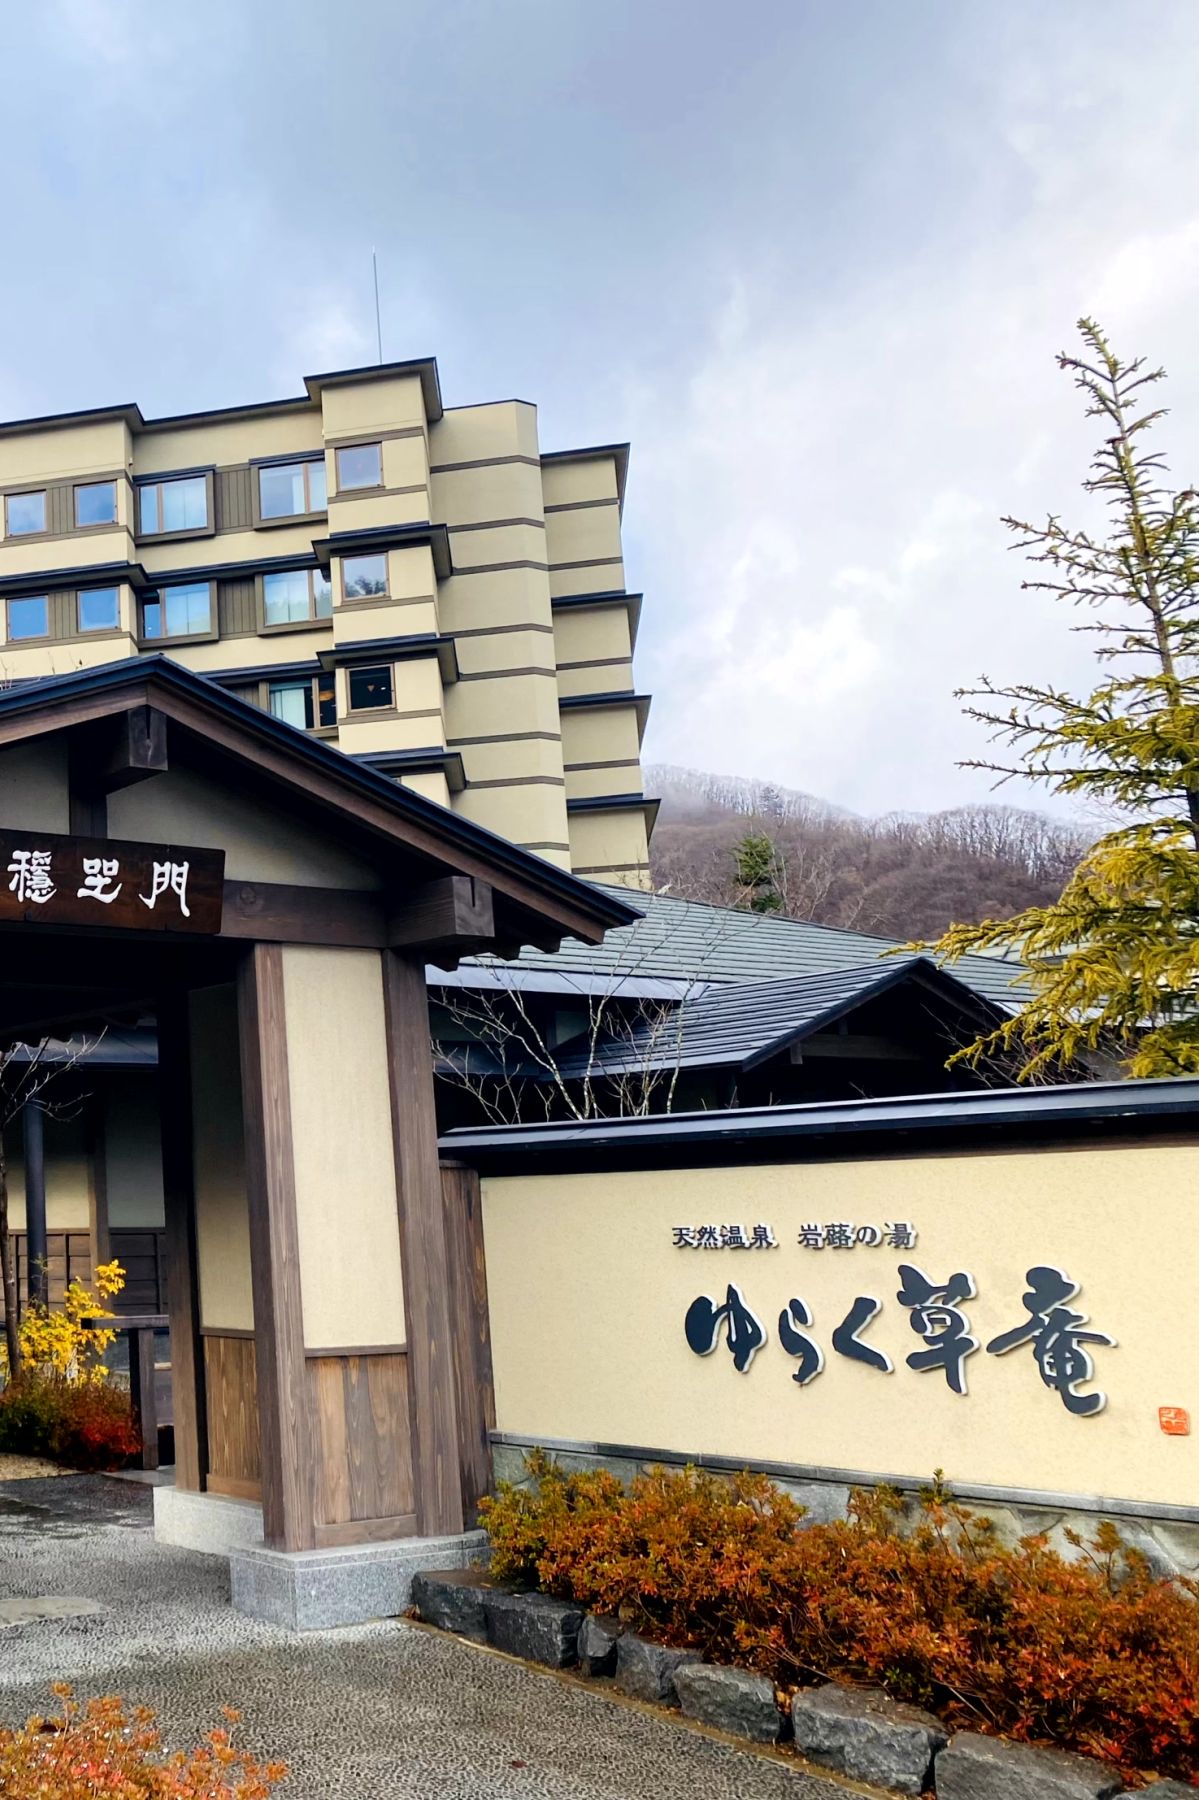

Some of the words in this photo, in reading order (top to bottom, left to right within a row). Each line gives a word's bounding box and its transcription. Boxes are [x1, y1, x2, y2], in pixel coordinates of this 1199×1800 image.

[672, 1224, 776, 1251] 天然温泉
[797, 1222, 913, 1251] 岩蕗の湯
[685, 1264, 1115, 1417] ゆらく草庵
